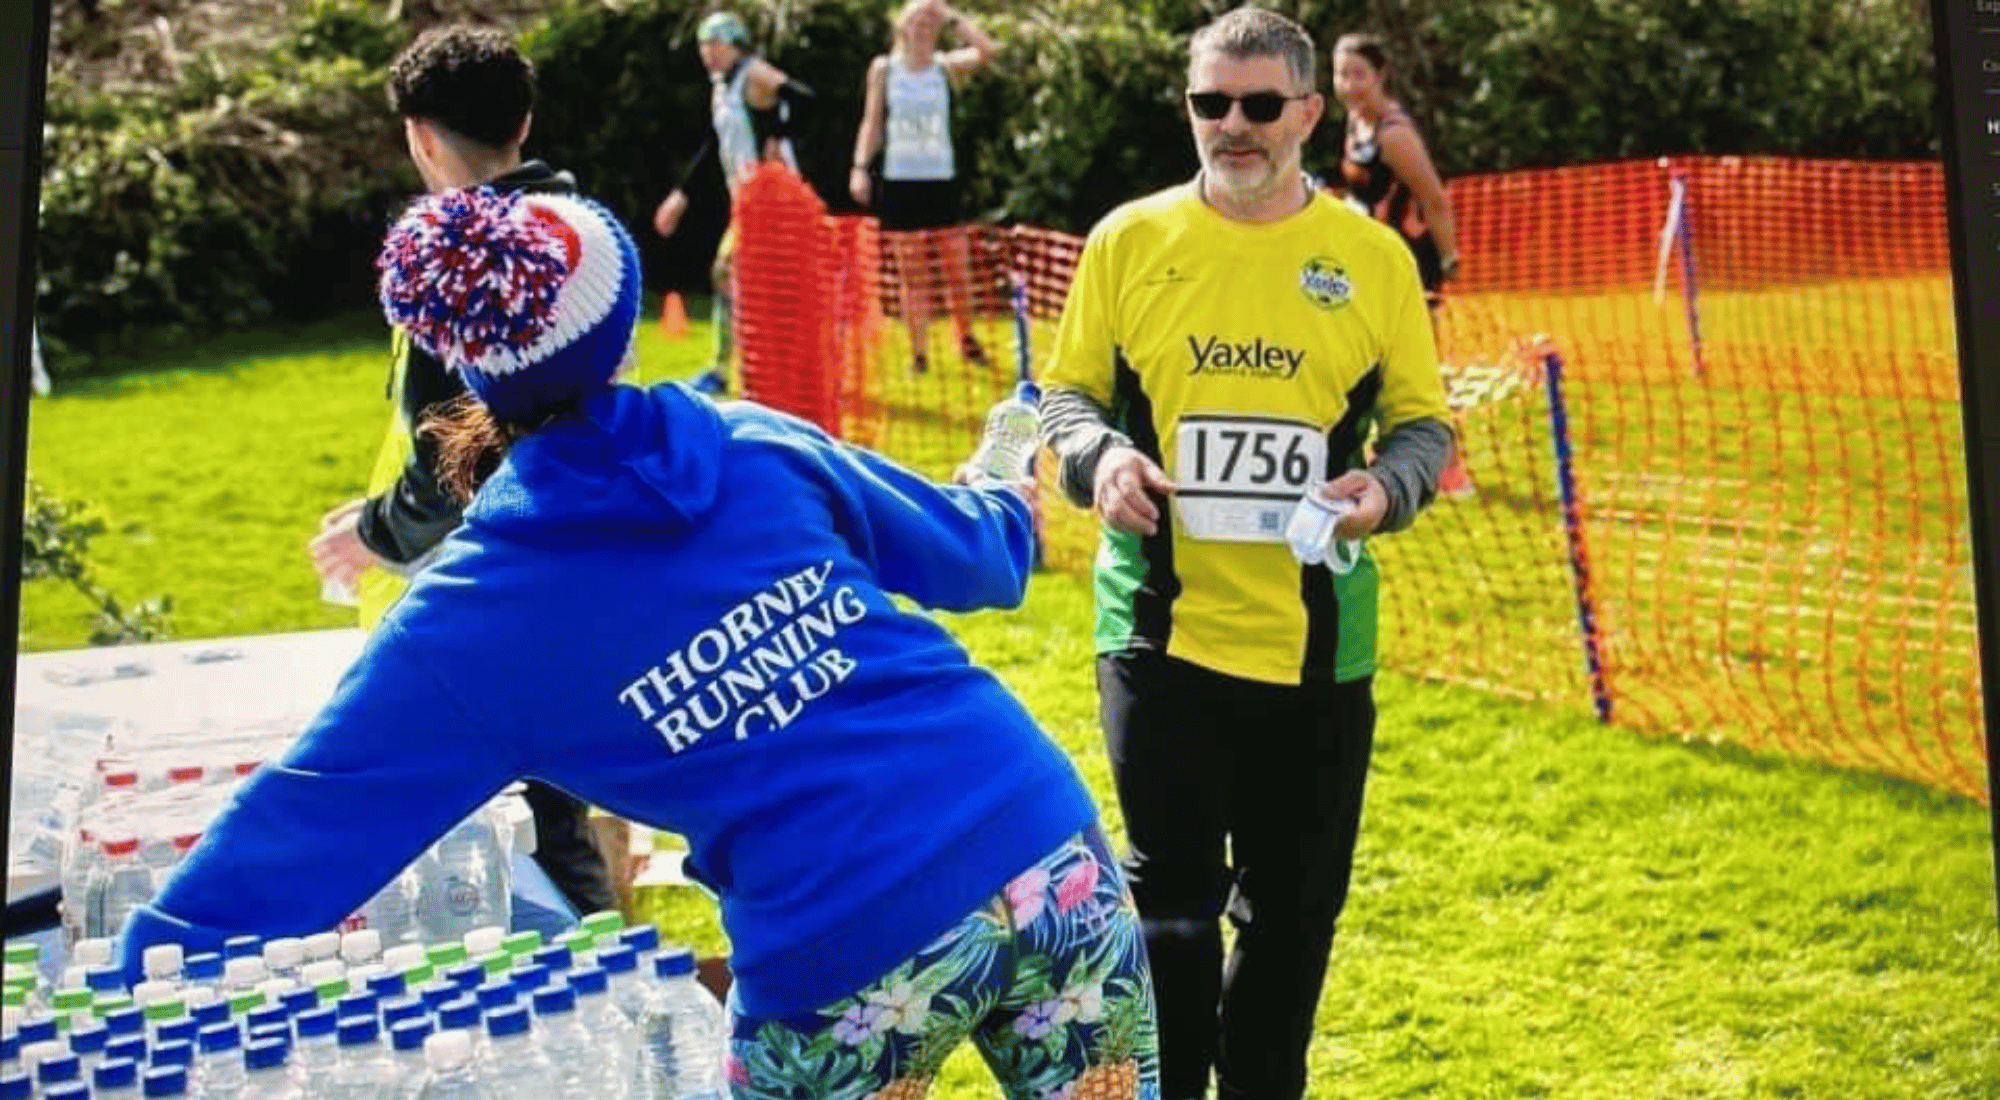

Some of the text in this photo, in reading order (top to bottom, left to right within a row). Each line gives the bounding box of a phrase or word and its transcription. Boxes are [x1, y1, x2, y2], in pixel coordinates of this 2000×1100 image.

[1187, 334, 1306, 379] Yaxley
[1195, 429, 1310, 486] 1756
[618, 559, 834, 721] THORNEY
[654, 585, 868, 753] RUNNING
[734, 648, 857, 740] CLUB
